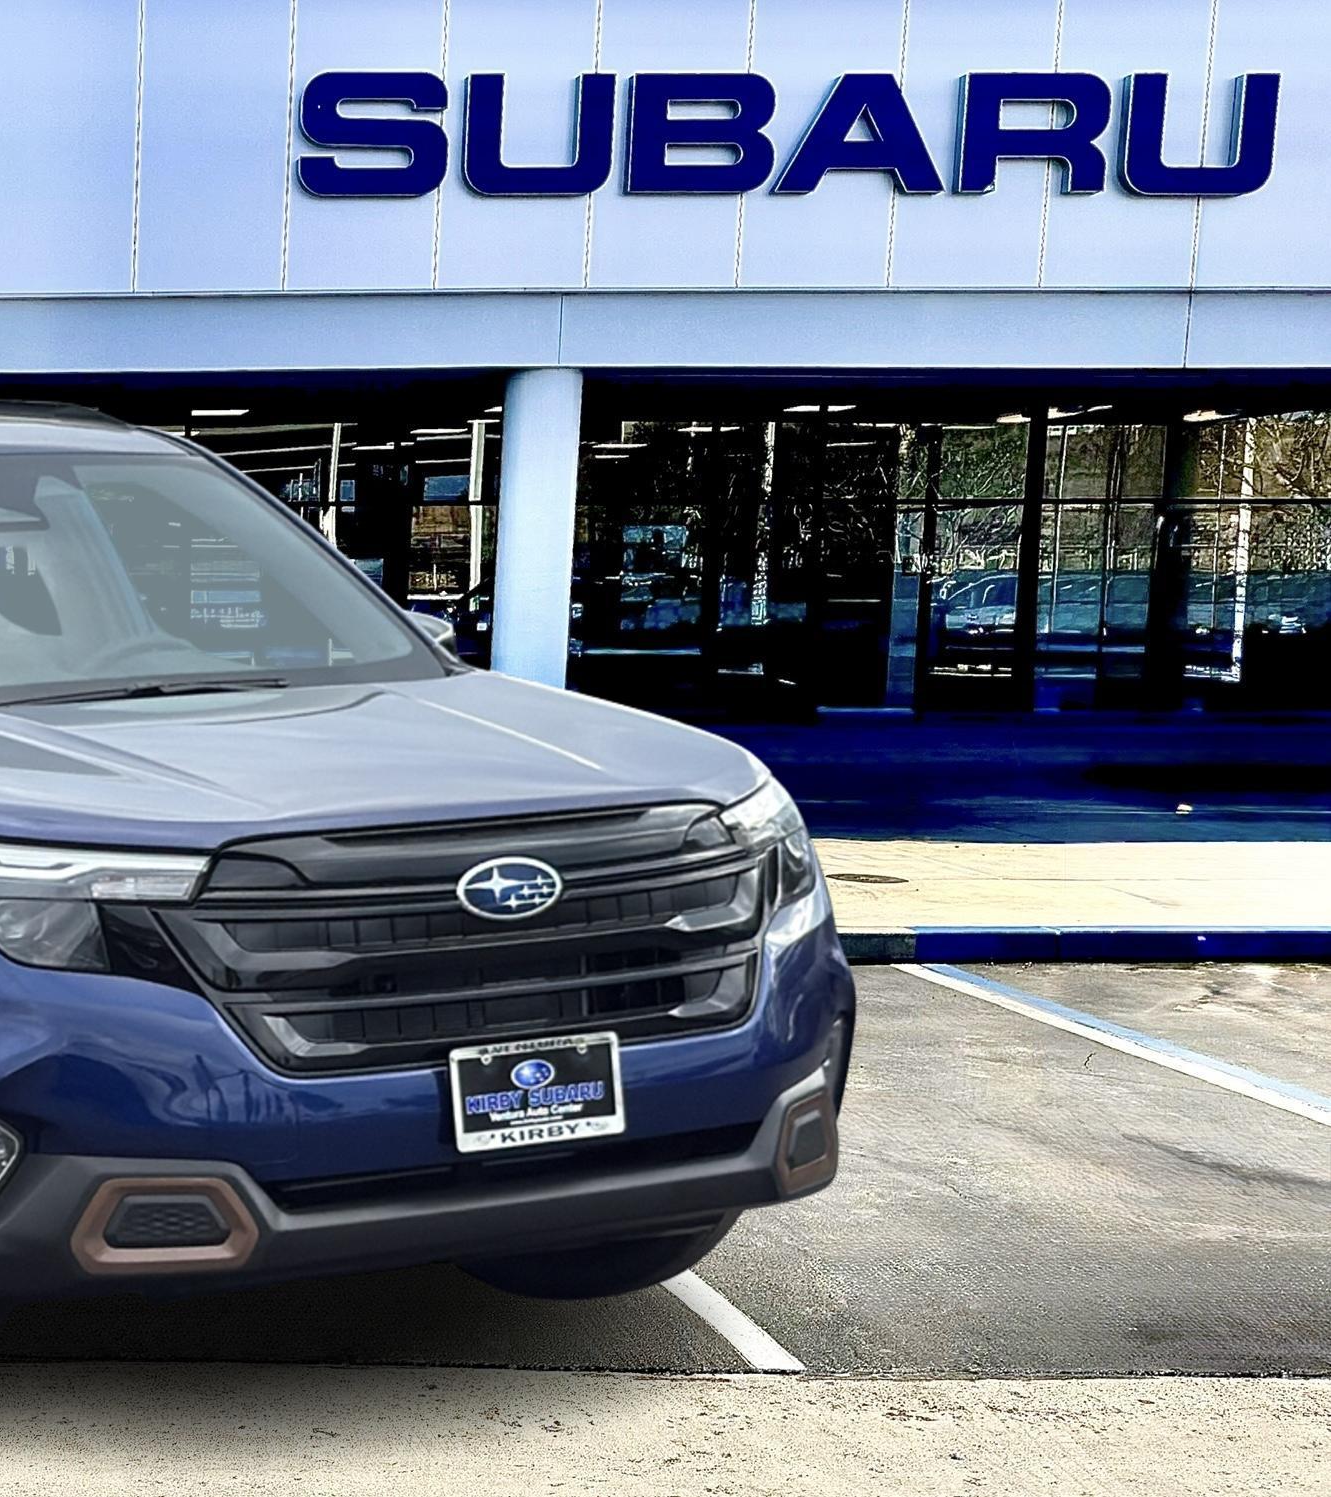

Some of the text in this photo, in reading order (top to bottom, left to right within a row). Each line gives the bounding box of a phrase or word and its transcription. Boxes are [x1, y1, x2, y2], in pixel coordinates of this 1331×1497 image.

[298, 69, 1281, 199] SUBARU
[465, 1081, 603, 1114] KIRBY SUBARU
[501, 1124, 578, 1142] KIRBY
